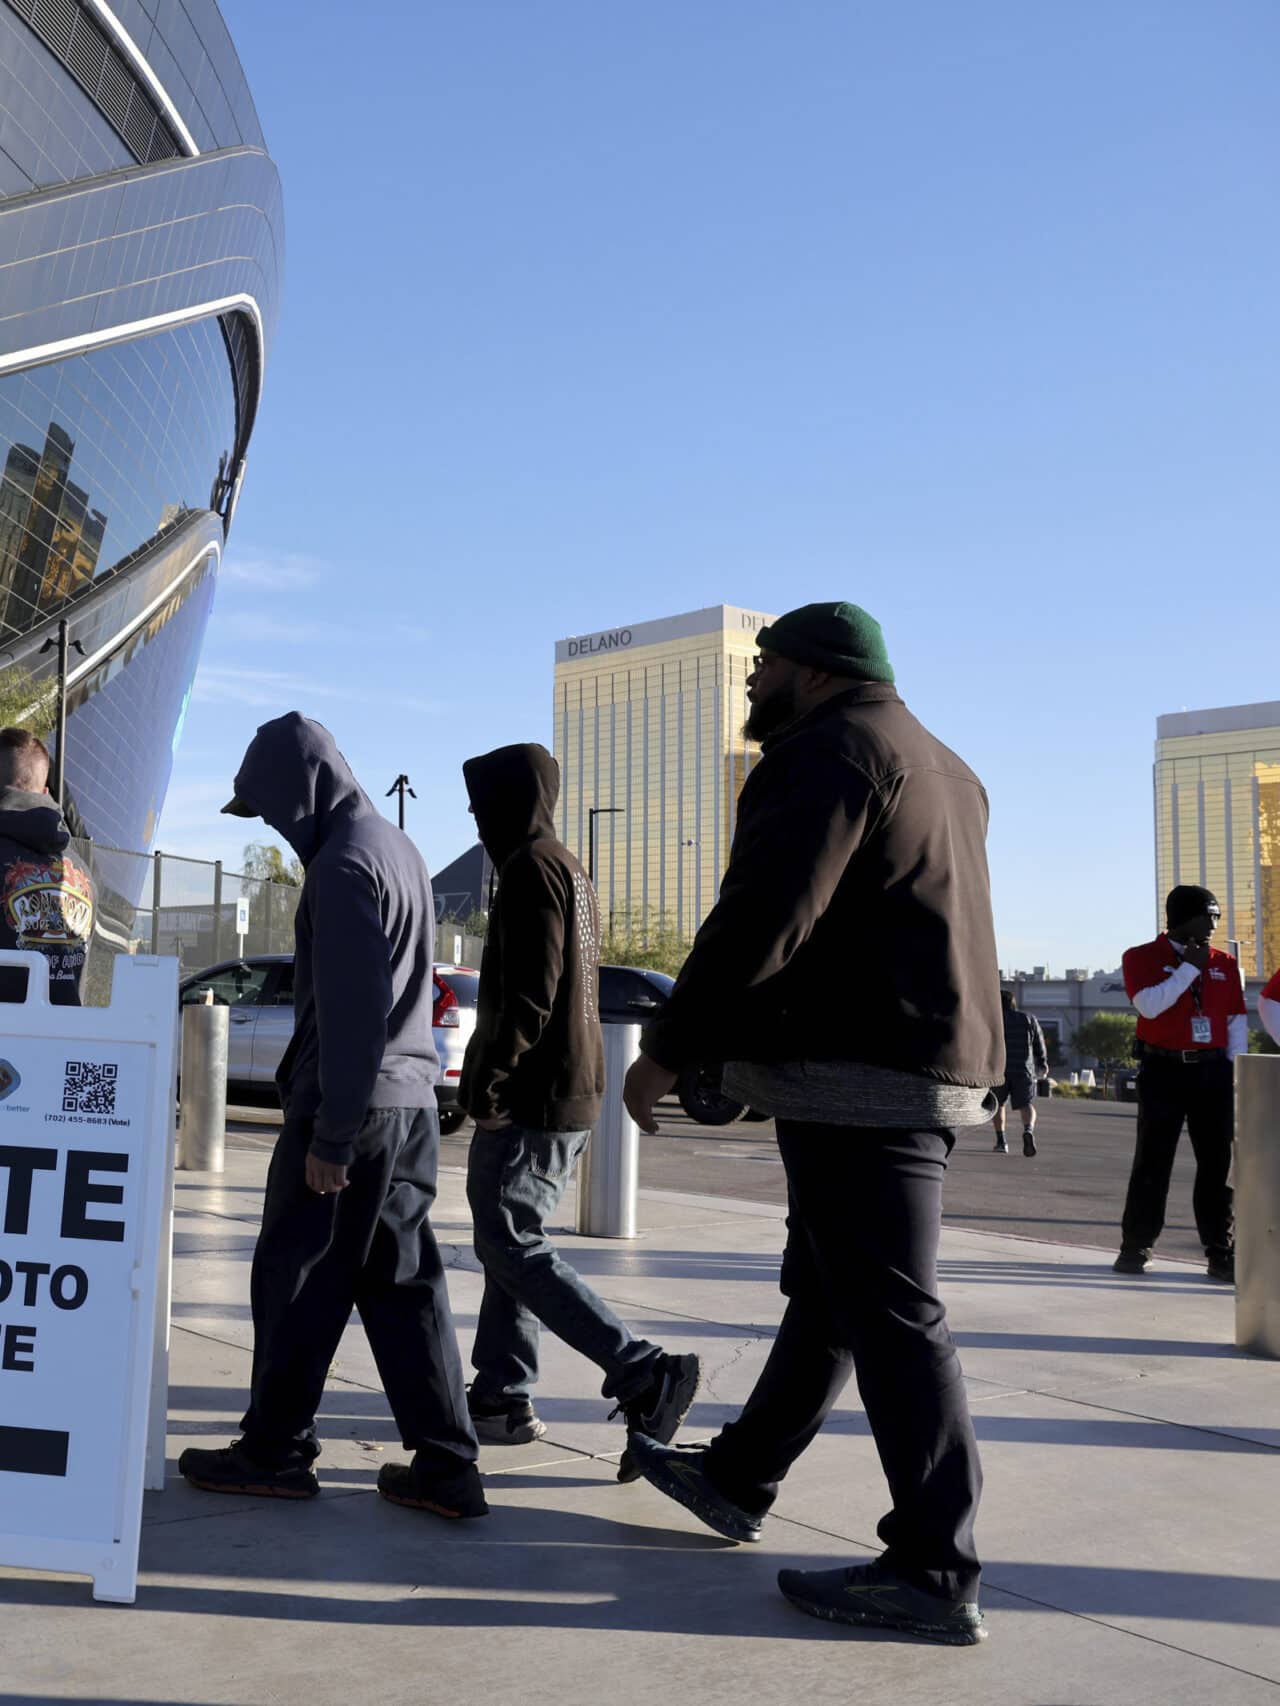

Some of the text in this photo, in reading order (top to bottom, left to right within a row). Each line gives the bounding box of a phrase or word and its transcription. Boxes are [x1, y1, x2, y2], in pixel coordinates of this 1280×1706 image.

[568, 629, 633, 657] DELANO
[44, 1114, 67, 1123] (702)
[108, 1118, 131, 1127] (Vote)
